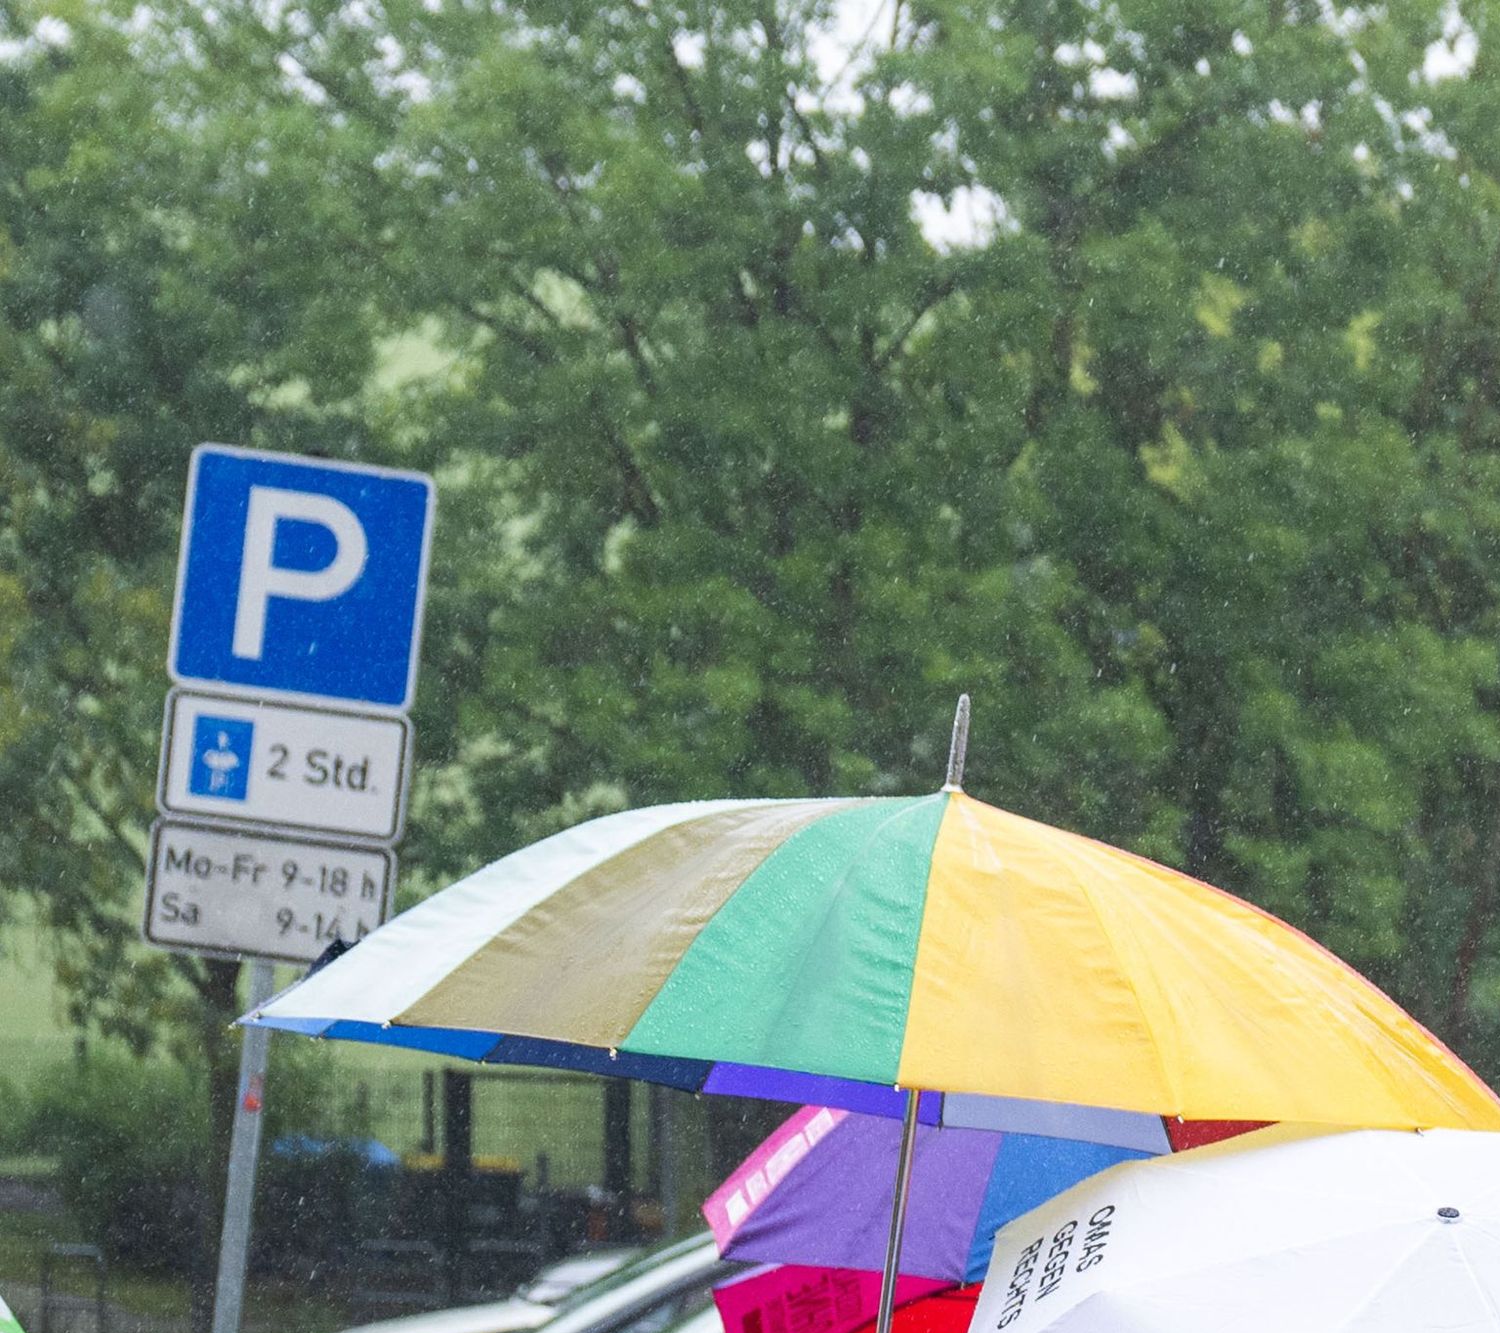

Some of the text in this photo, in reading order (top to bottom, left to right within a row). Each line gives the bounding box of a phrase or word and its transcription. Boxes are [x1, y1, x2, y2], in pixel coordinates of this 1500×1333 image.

[231, 485, 368, 661] P
[266, 743, 379, 794] 2 Std.
[164, 845, 376, 899] Mo-Fr 9-18 h
[161, 890, 200, 926] Sa
[1034, 1219, 1079, 1302] GEGEN
[1075, 1204, 1116, 1274] OMAS
[996, 1236, 1045, 1330] RECHTS
